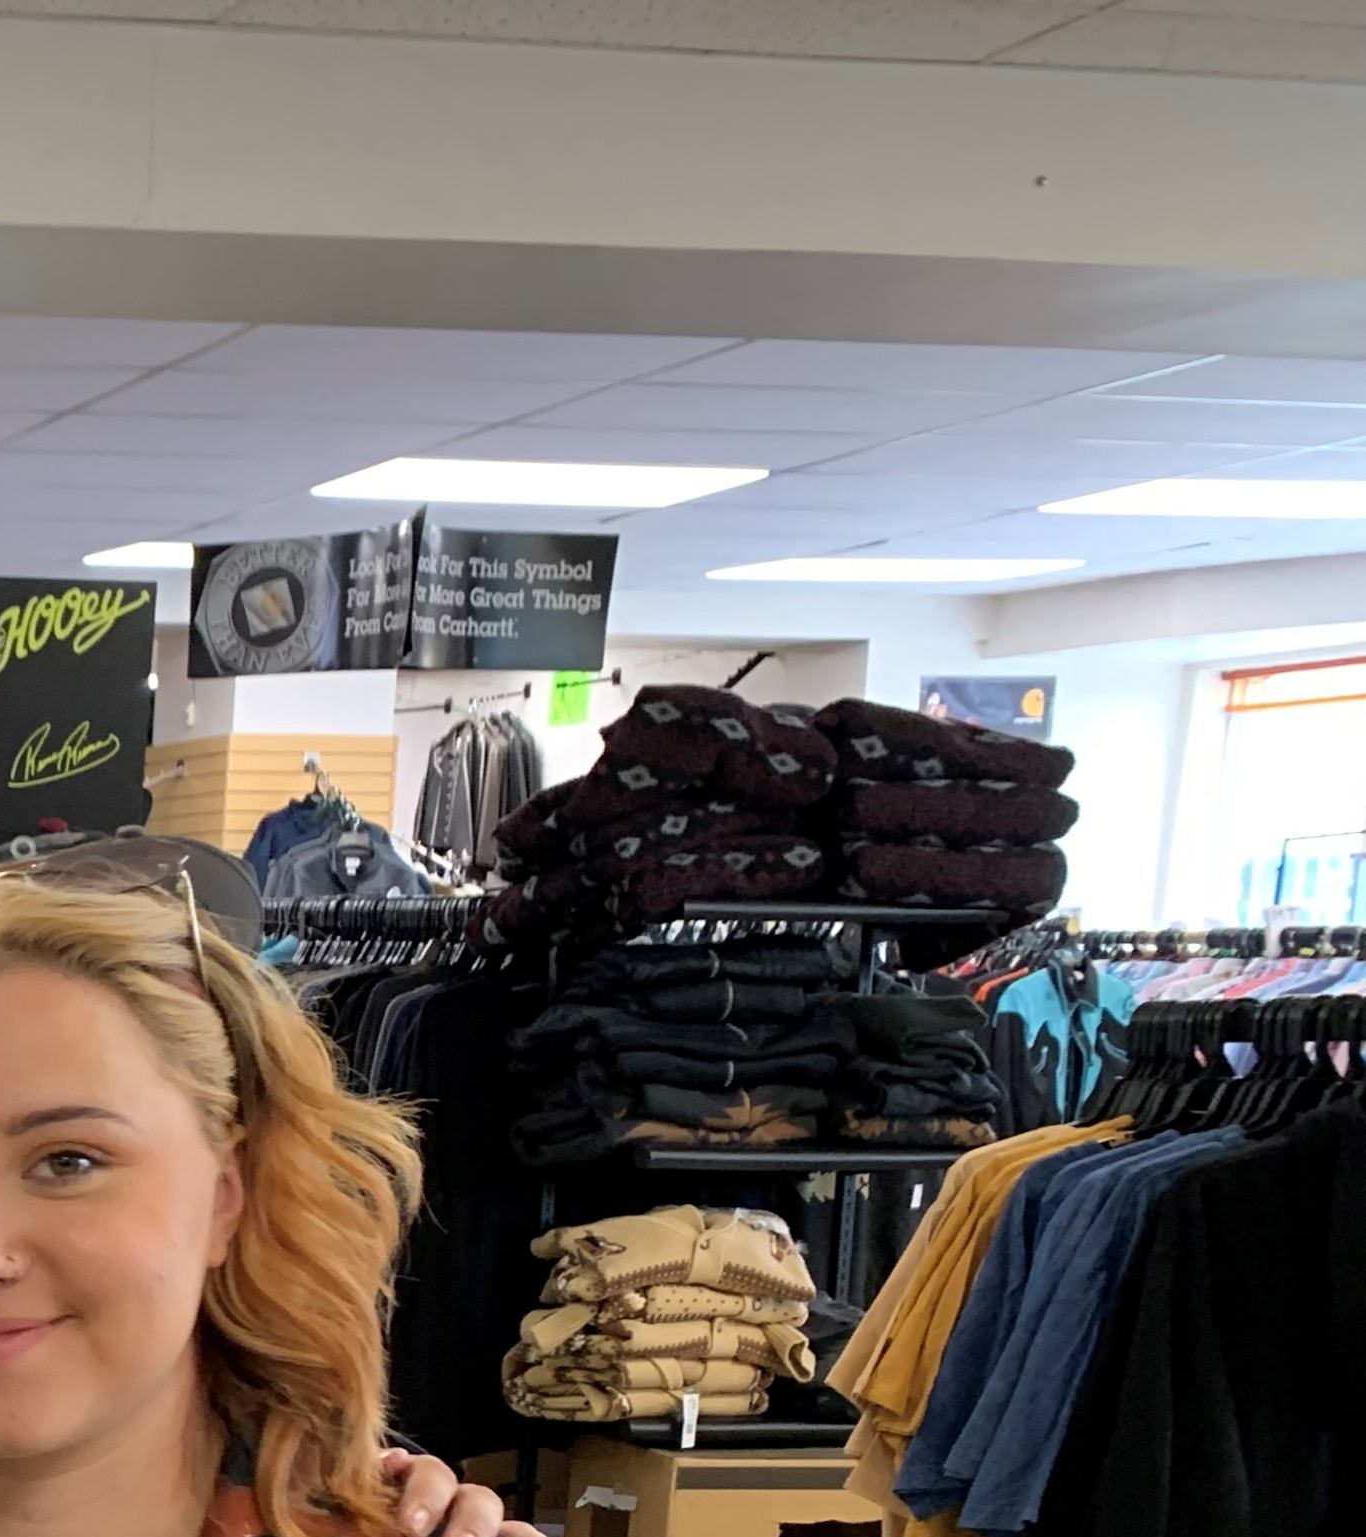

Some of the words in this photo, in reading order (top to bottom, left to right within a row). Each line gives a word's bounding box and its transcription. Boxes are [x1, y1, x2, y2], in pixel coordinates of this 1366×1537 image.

[220, 544, 314, 585] BETTER
[418, 553, 438, 575] ook
[440, 555, 464, 578] For
[469, 557, 508, 580] This
[514, 558, 593, 584] Symbol
[347, 587, 370, 608] For
[429, 583, 465, 608] More
[470, 586, 525, 609] Great
[532, 589, 602, 615] Things
[345, 616, 381, 638] From
